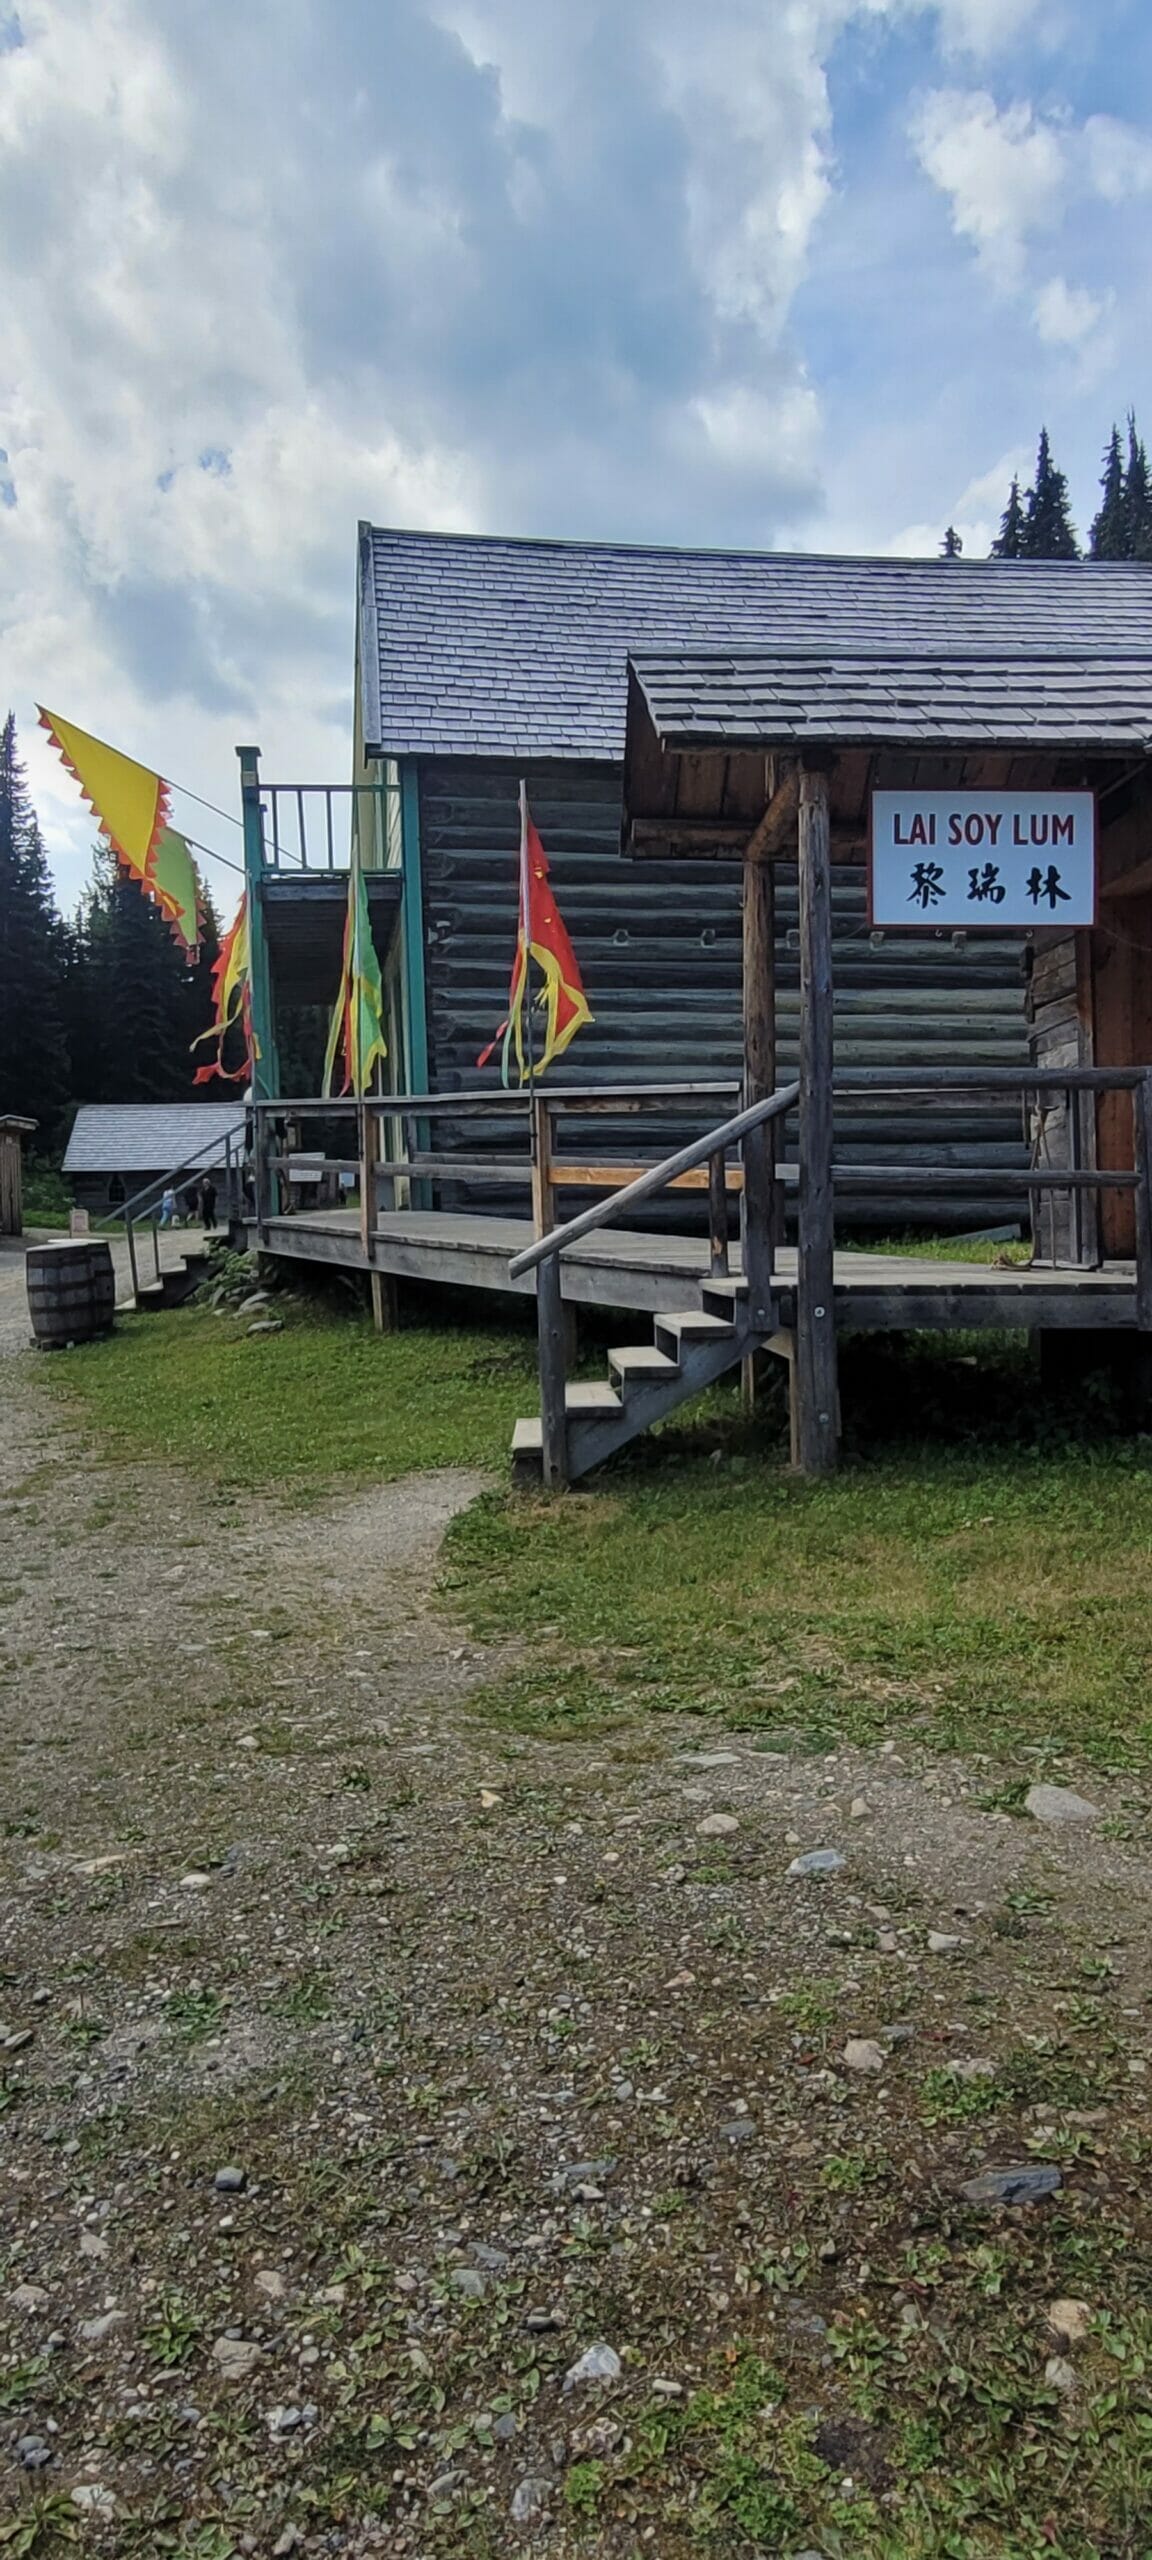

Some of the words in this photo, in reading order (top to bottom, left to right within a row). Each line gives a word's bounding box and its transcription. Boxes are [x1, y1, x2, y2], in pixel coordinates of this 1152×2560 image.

[893, 813, 936, 846] LAI
[947, 813, 1003, 846] SOY
[1013, 813, 1075, 846] LUM
[906, 861, 1073, 910] 黎瑞林
